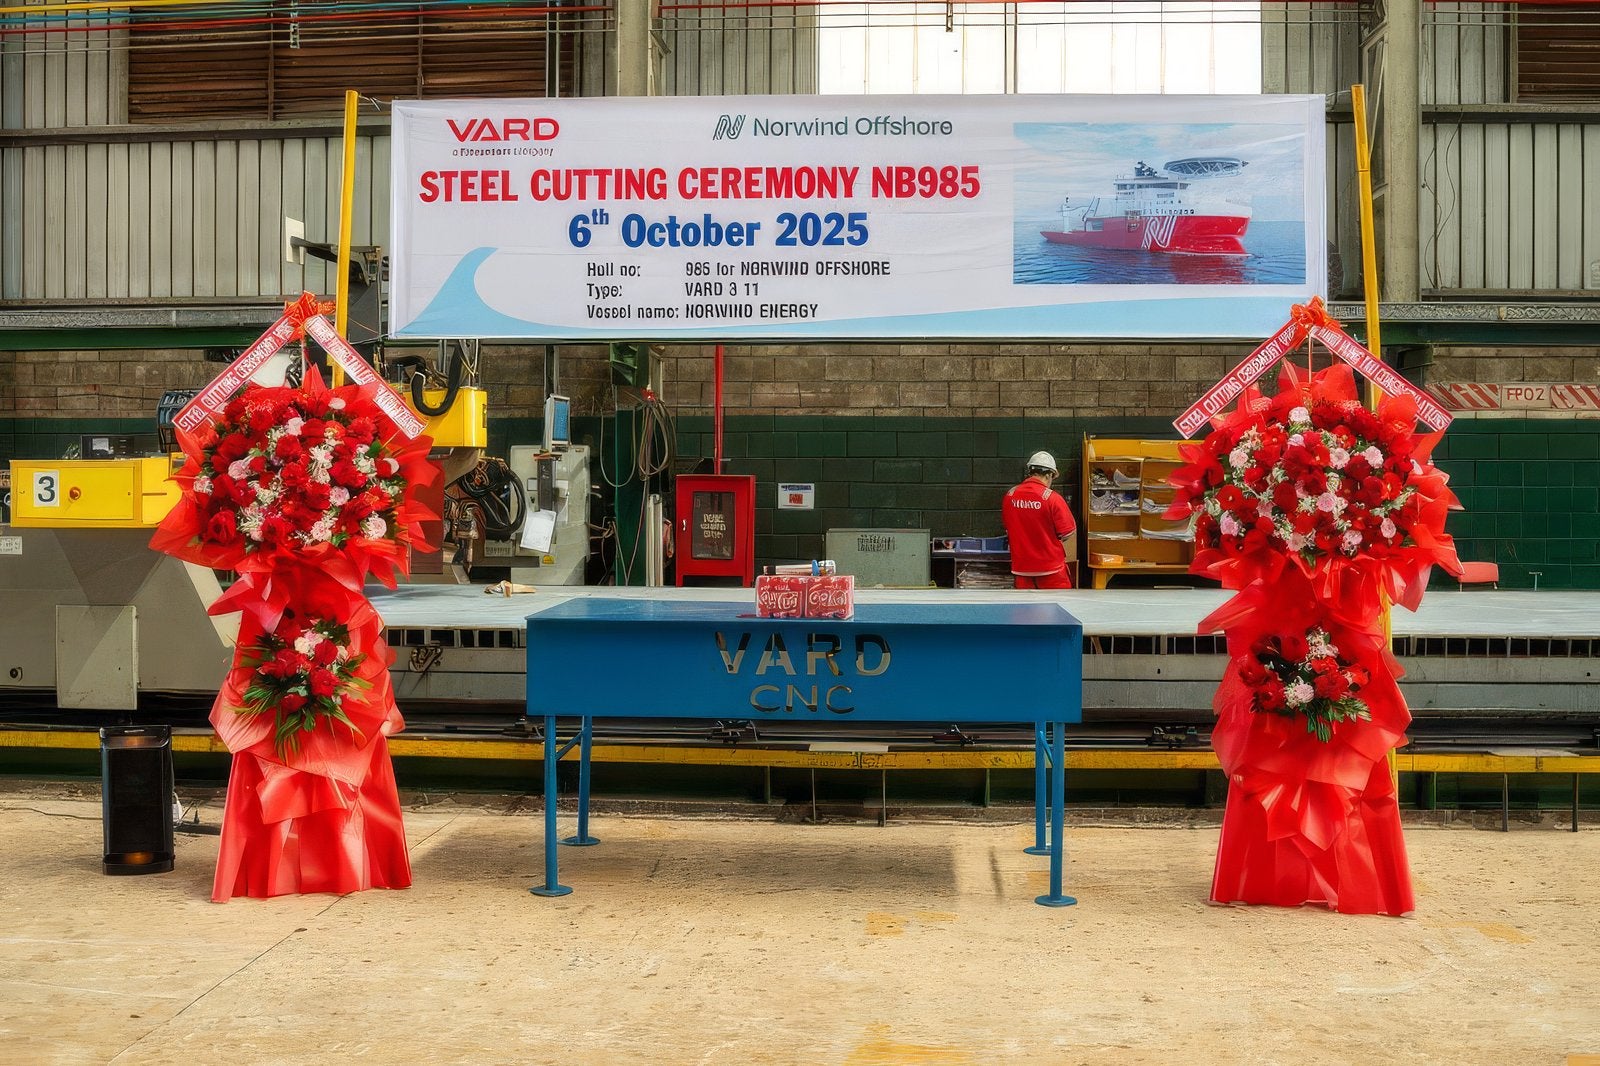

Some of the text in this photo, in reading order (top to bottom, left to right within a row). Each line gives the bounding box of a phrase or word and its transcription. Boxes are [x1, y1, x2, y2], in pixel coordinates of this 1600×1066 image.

[446, 118, 560, 142] VARD
[753, 115, 953, 137] Norwind Offshore
[419, 165, 981, 203] STEEL CUTTING CEREMONY NB985
[568, 208, 869, 248] 6th October 2025
[740, 261, 809, 276] NORWIND
[815, 261, 891, 276] OFFSHORE
[685, 282, 723, 297] VARD
[685, 303, 753, 319] NORWIND
[760, 303, 819, 318] ENERGY
[38, 475, 56, 503] 3
[714, 631, 892, 677] VARD
[750, 684, 856, 715] CNC
